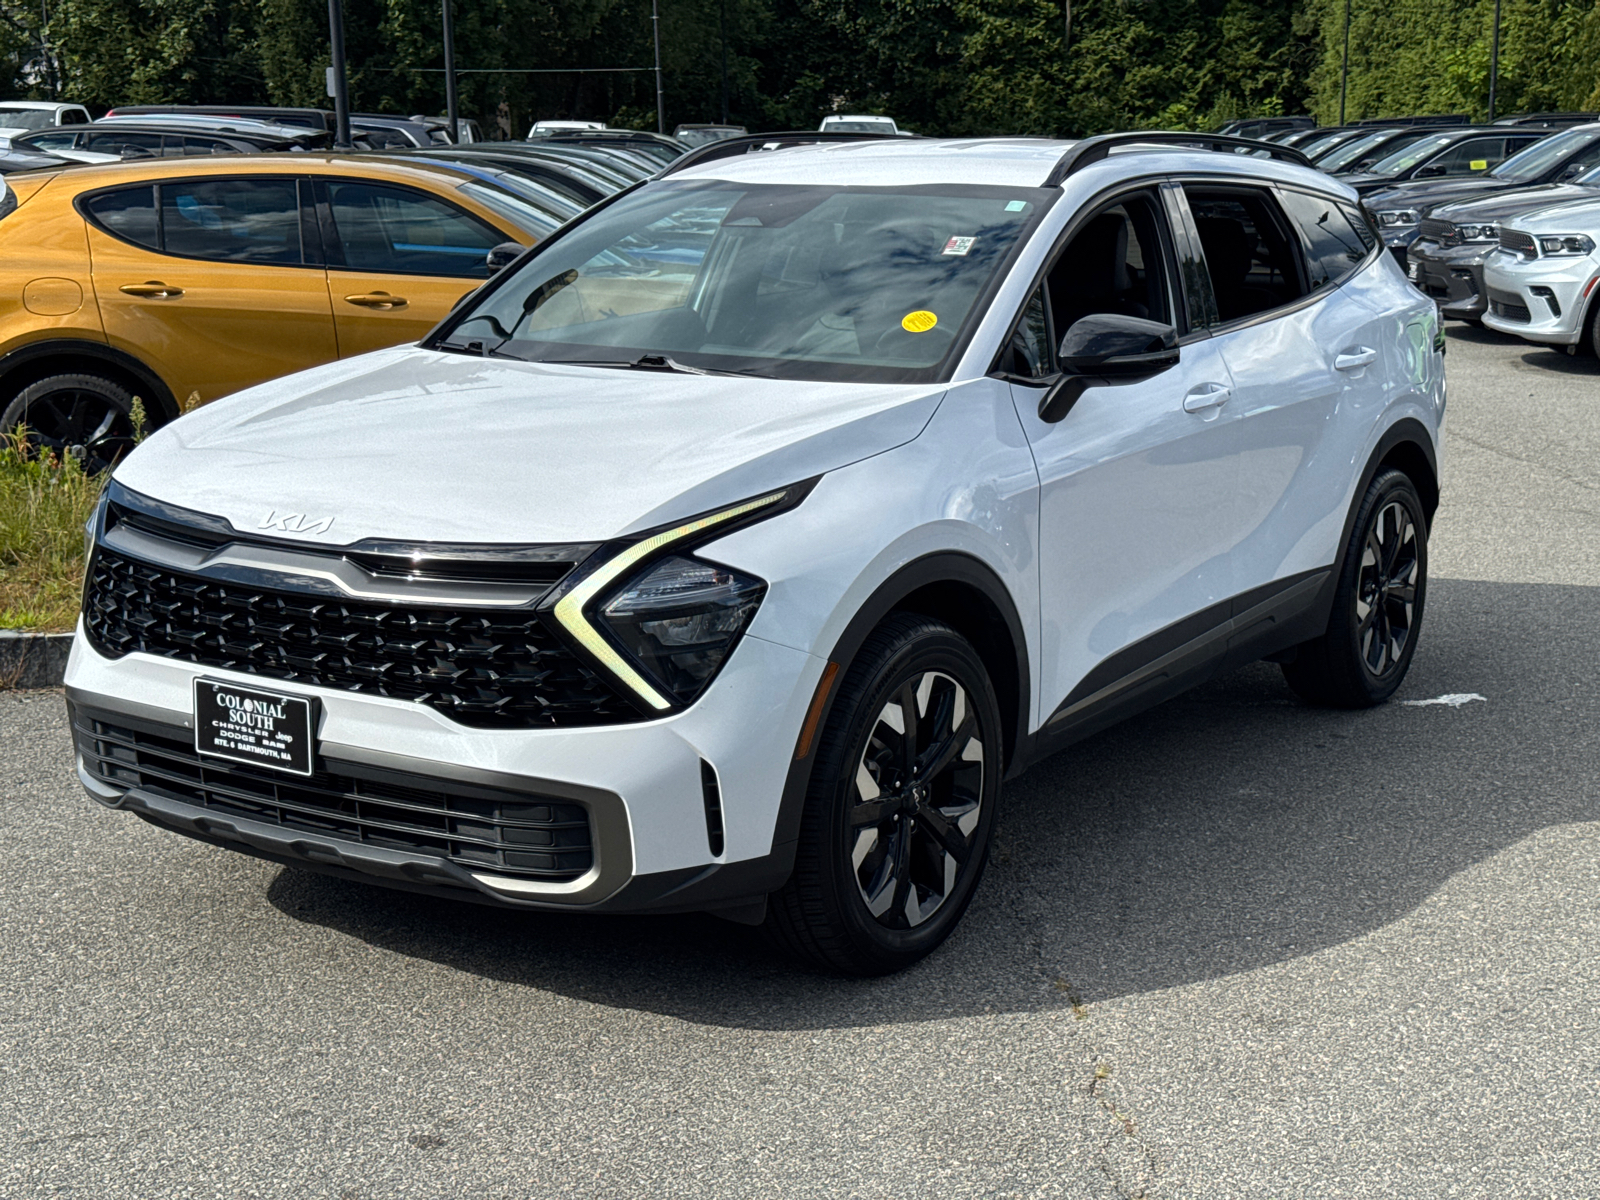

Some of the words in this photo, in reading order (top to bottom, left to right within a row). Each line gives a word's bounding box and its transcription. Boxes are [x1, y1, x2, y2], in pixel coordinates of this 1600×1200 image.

[257, 510, 335, 535] KIA
[216, 692, 286, 719] COLONIAL
[211, 720, 269, 737] CHRYSLER
[275, 731, 293, 743] Jeep
[229, 709, 274, 731] SOUTH
[214, 737, 230, 748] RTE.
[237, 742, 280, 759] DARTMOUTH,
[281, 751, 293, 761] MA
[219, 730, 256, 743] DODGE
[262, 739, 286, 749] RAM
